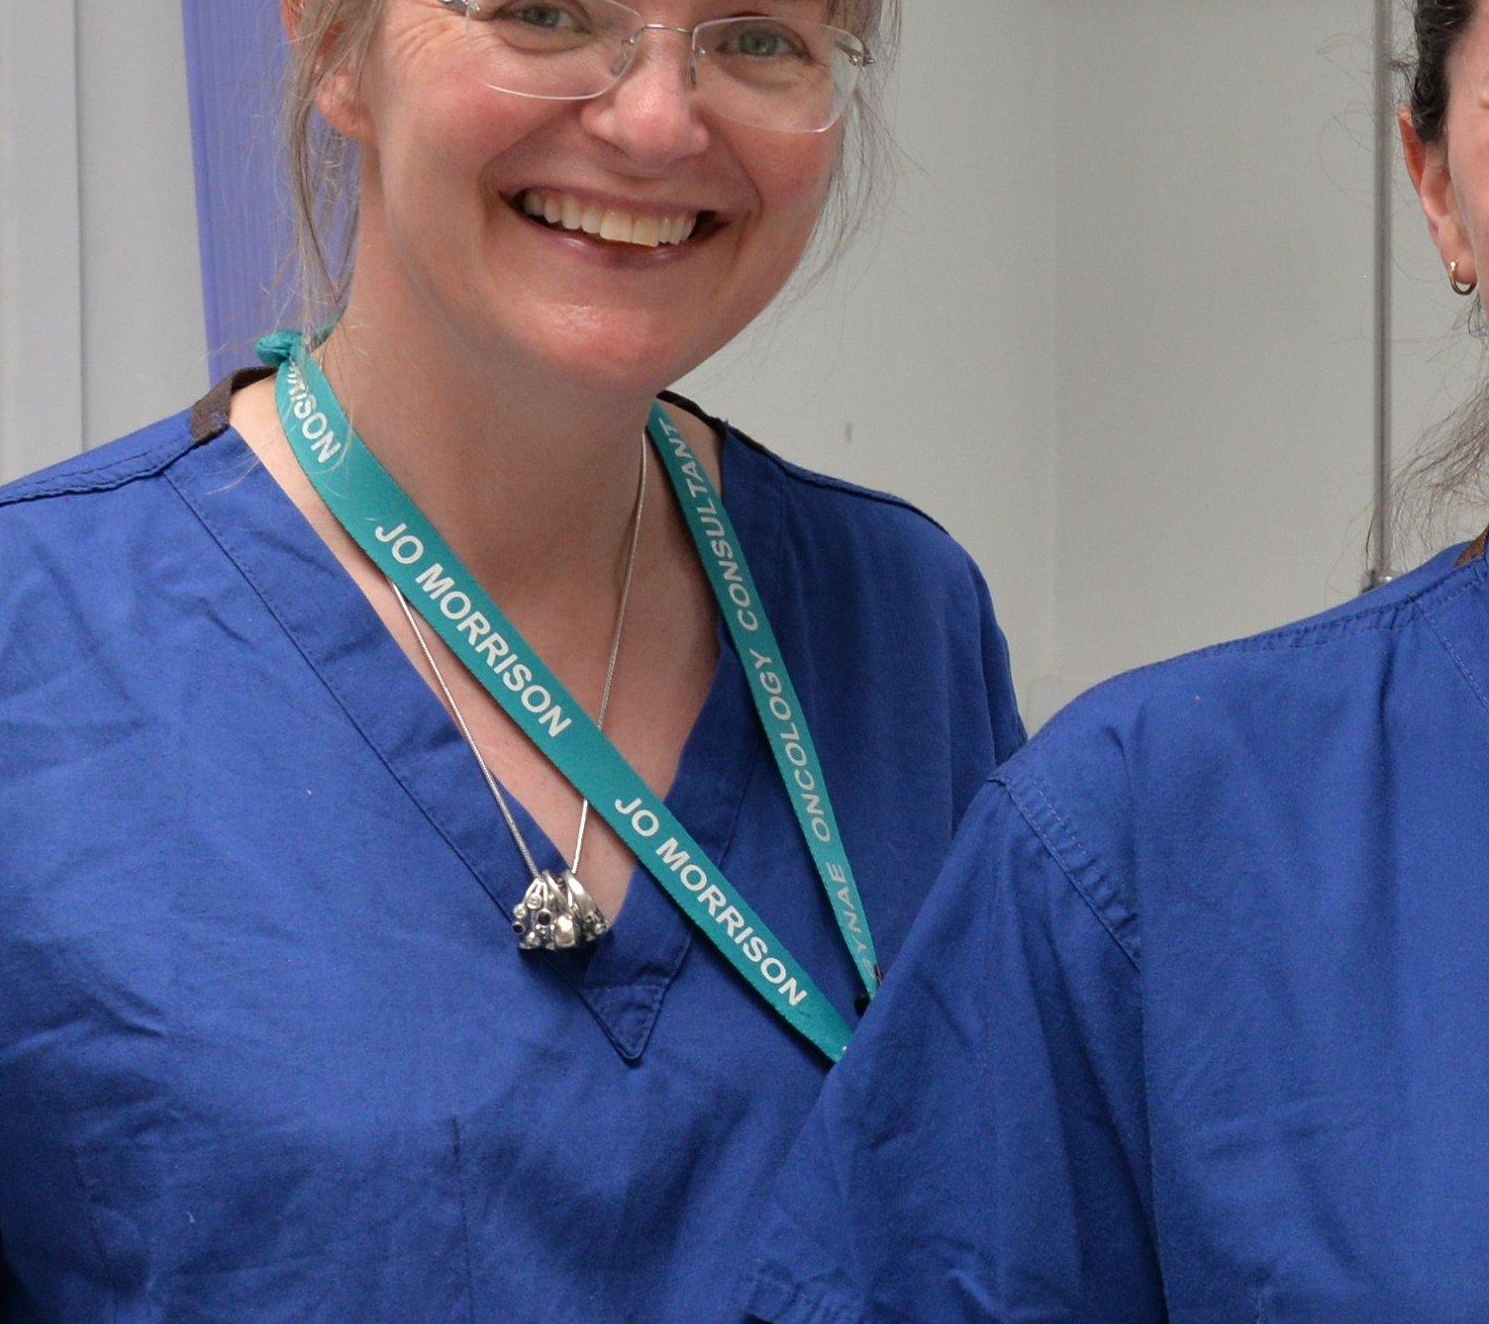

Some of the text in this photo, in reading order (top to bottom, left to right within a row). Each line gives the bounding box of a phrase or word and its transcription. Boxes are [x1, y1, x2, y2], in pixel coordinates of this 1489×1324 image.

[375, 522, 573, 738] JO MORRISON
[659, 417, 758, 631] CONSULTANT
[748, 647, 831, 844] ONCOLOGY
[614, 796, 808, 1008] JO MORRISON
